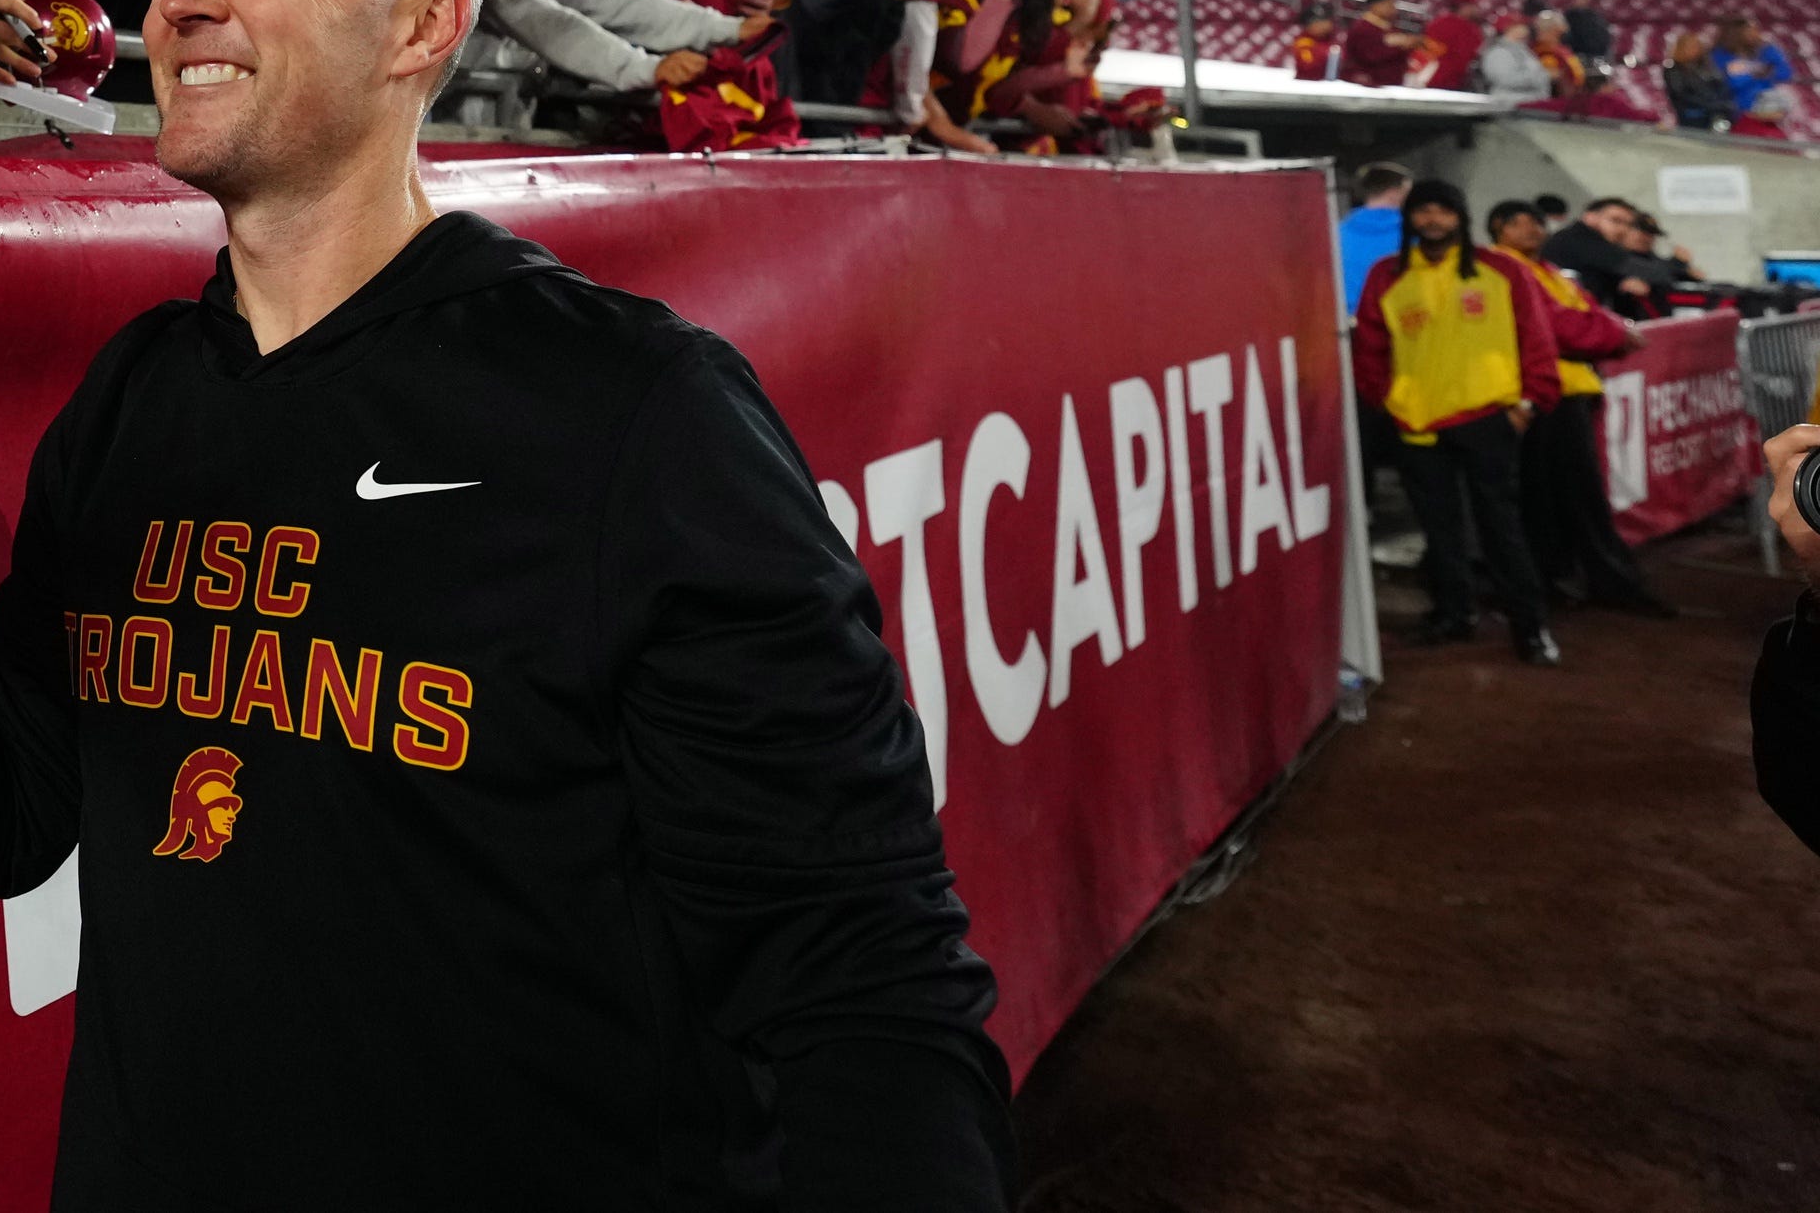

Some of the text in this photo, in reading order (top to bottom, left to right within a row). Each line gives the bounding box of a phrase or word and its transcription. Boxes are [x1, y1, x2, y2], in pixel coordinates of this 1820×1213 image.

[132, 520, 320, 618] USC
[818, 335, 1331, 814] TCAPITAL
[64, 611, 473, 771] TROJANS
